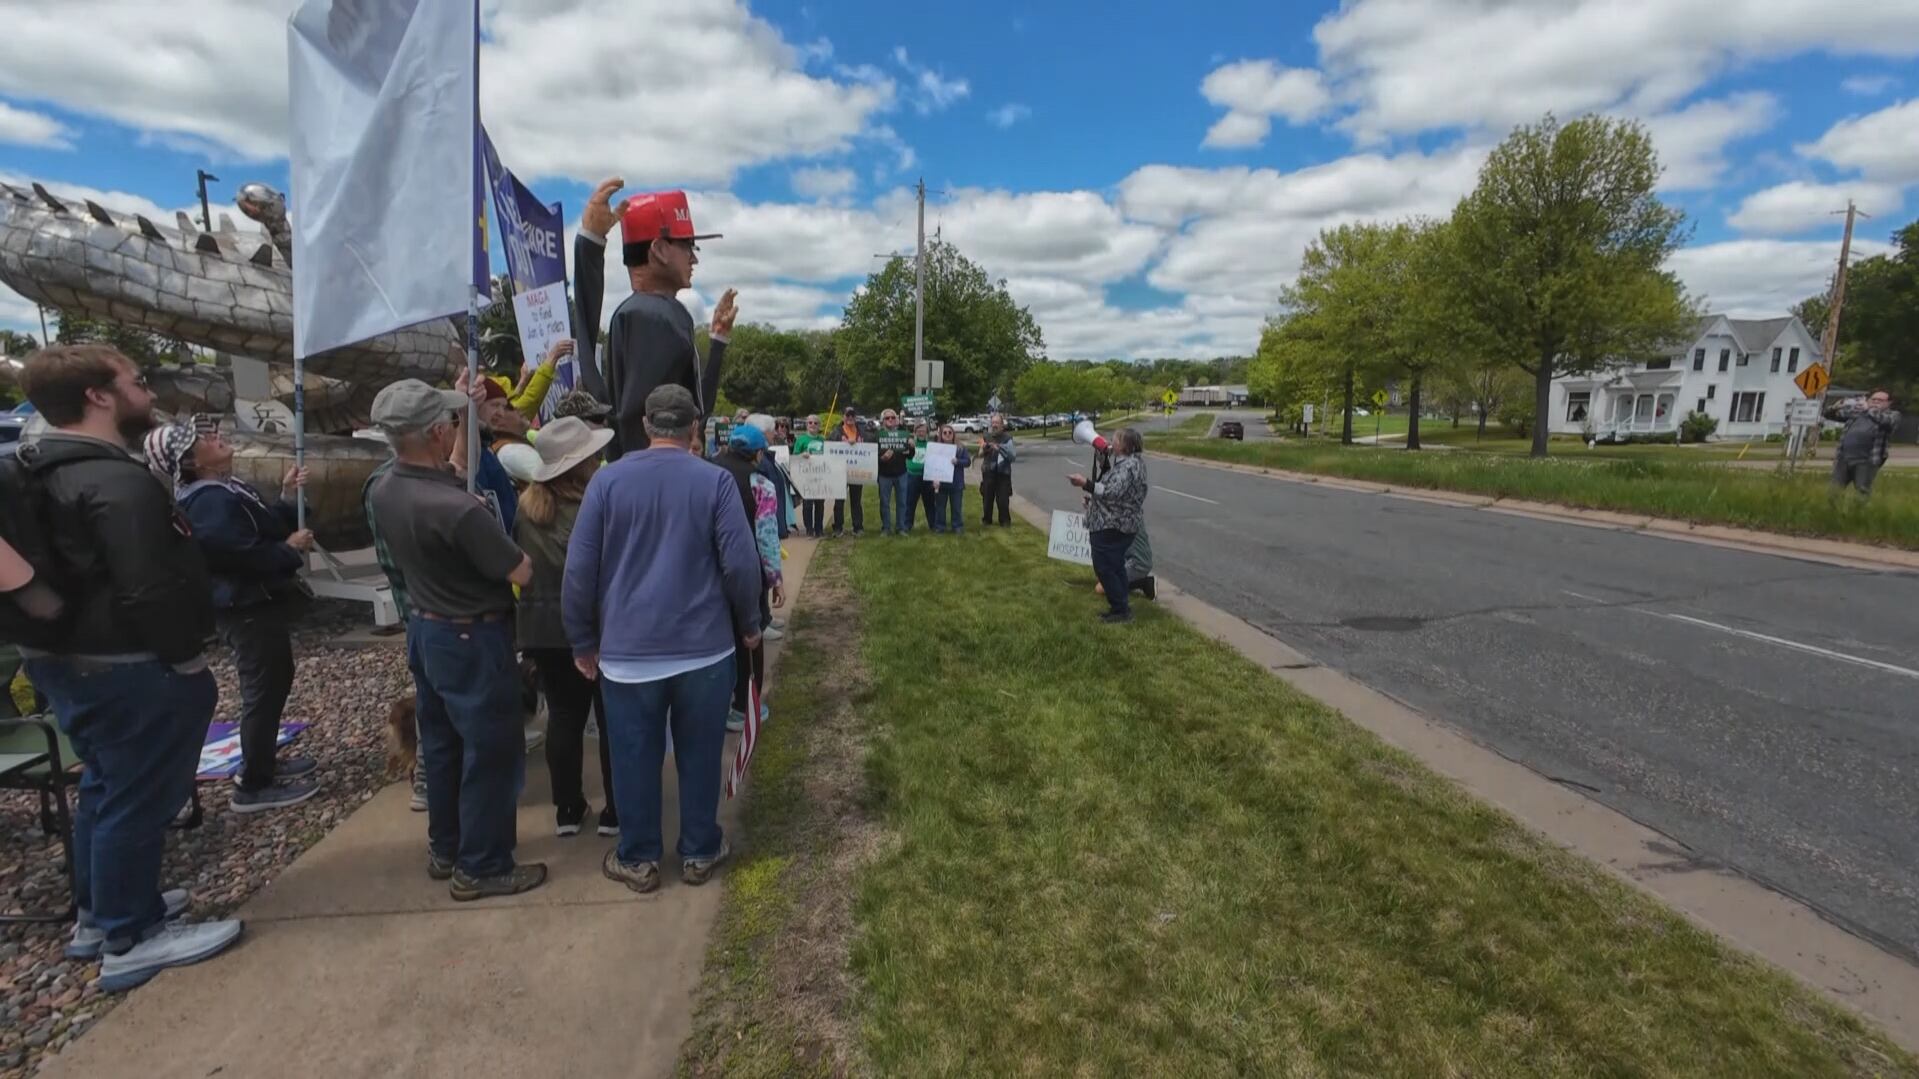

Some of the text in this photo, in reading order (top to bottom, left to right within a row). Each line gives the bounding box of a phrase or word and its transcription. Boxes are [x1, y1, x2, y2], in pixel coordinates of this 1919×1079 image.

[527, 290, 549, 307] MAGA
[830, 448, 871, 457] DEMOCRACY
[798, 461, 832, 474] Patients
[1053, 543, 1090, 558] HOSPITA
